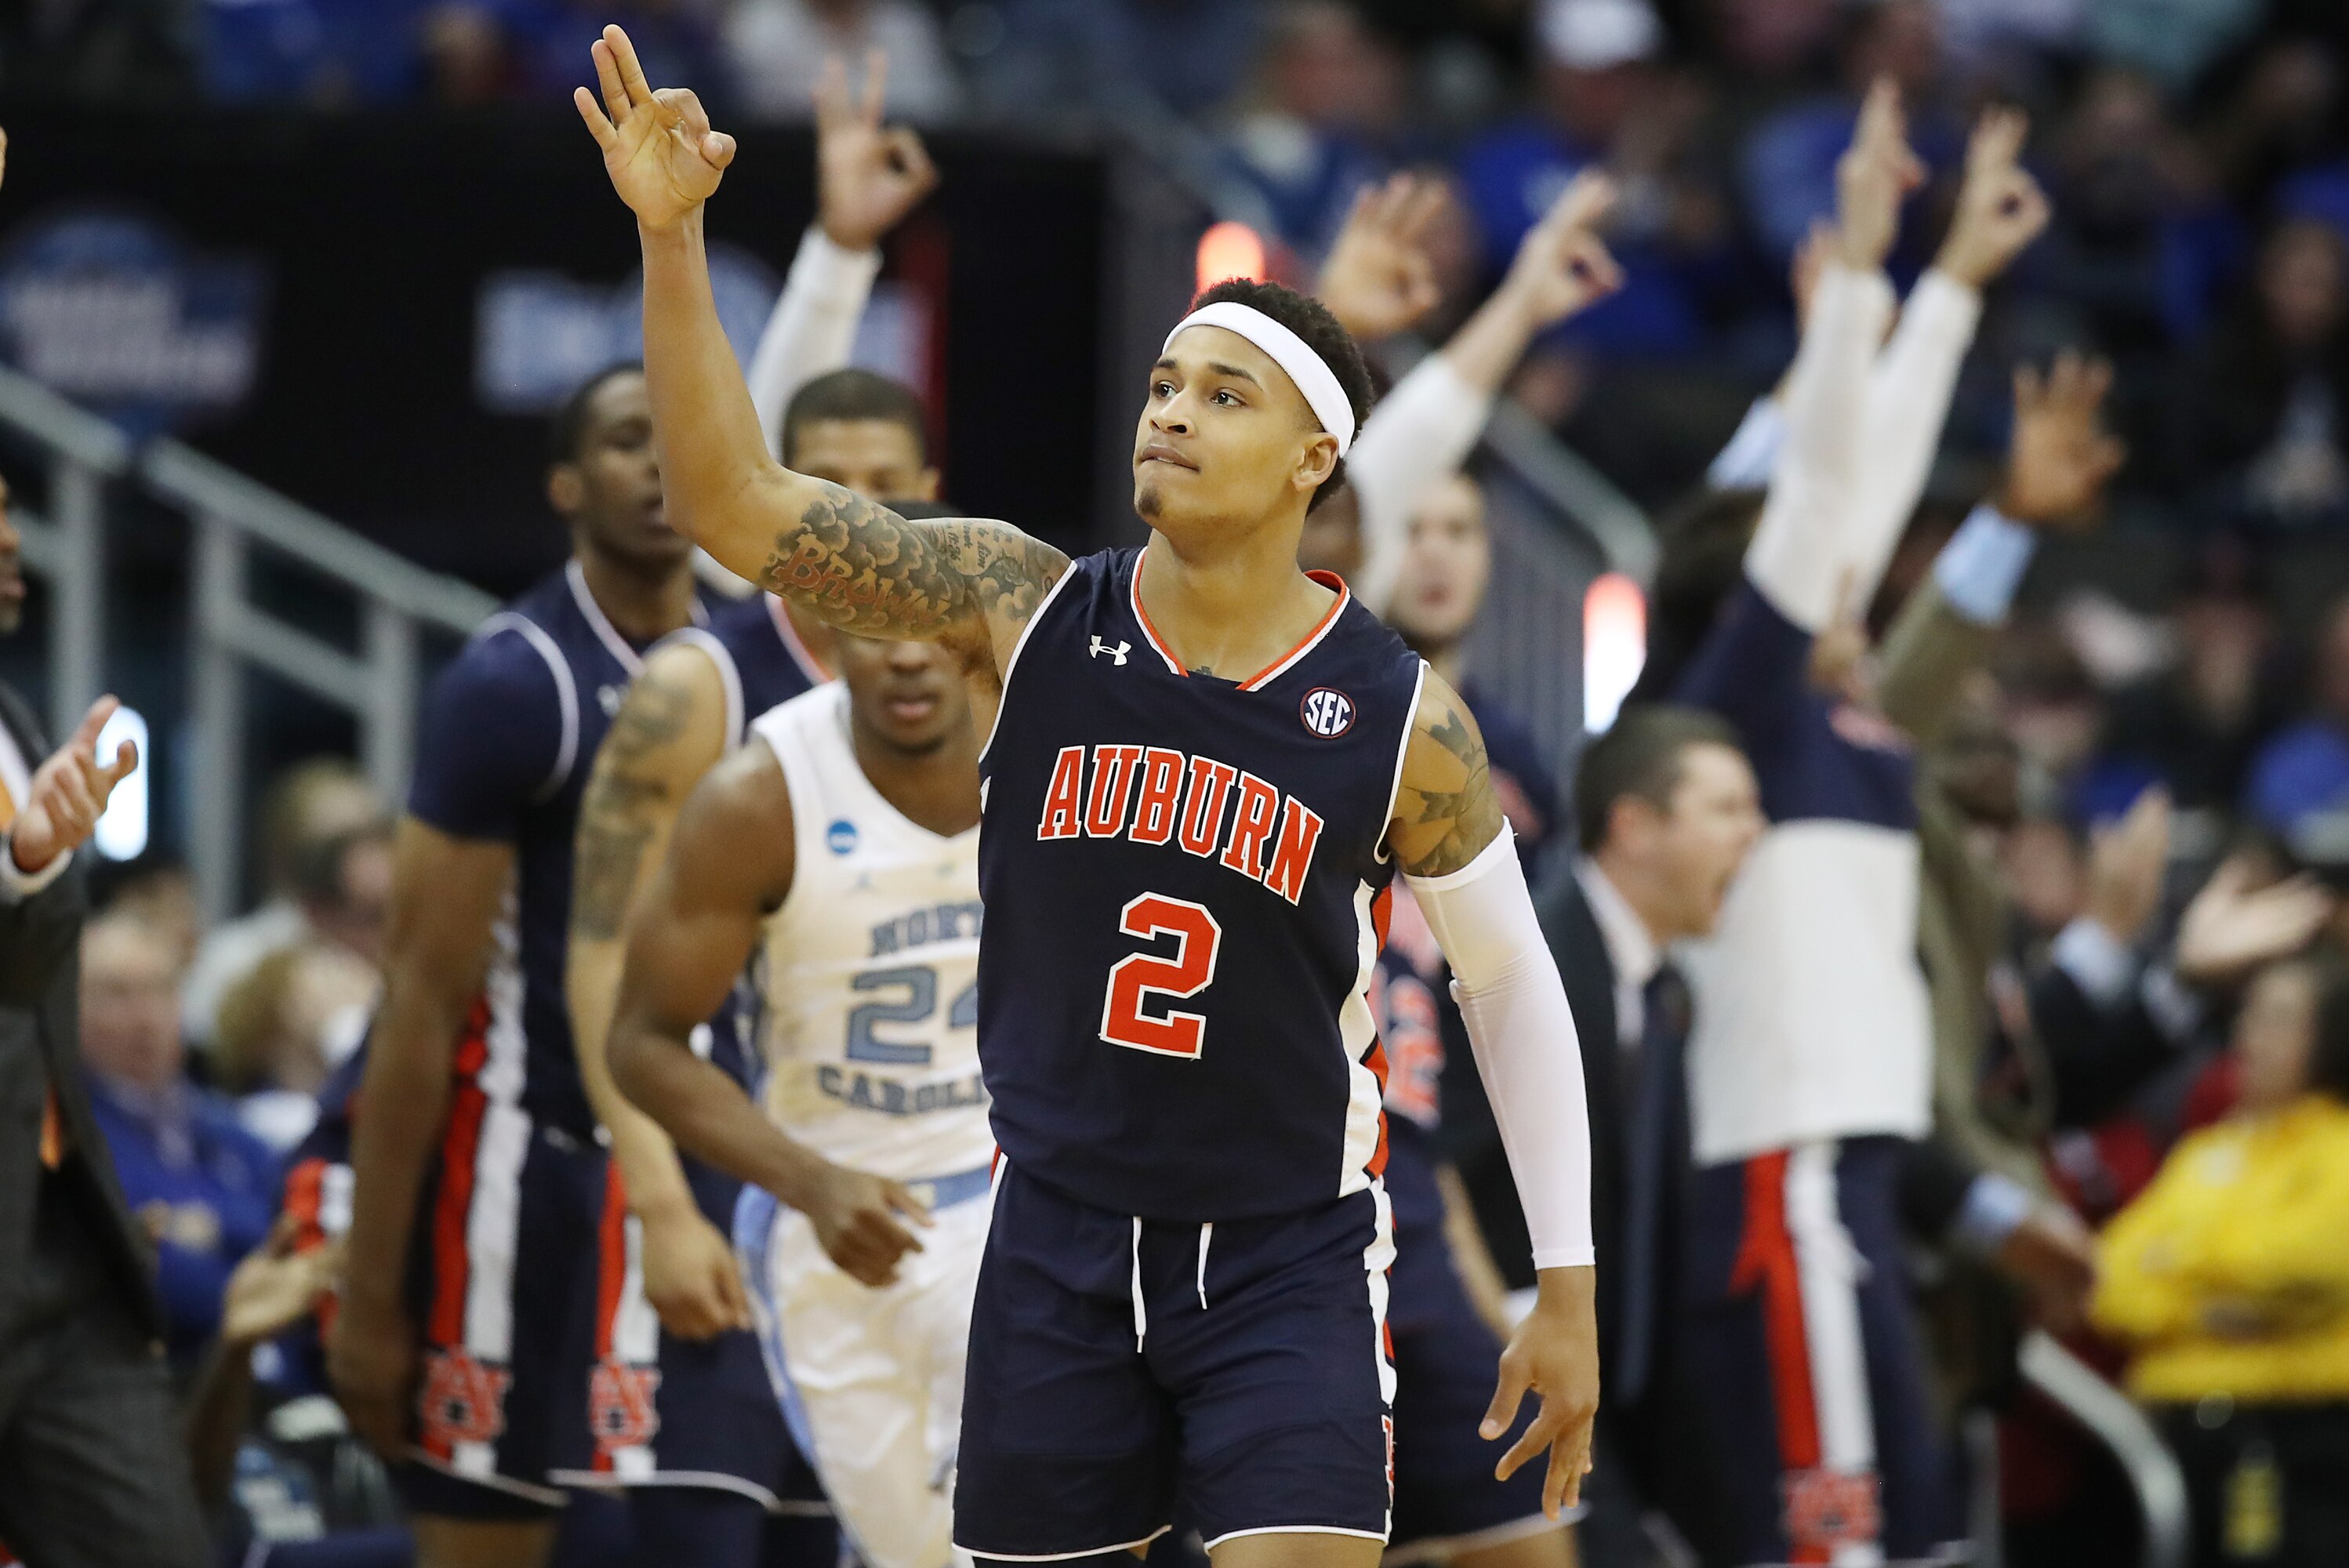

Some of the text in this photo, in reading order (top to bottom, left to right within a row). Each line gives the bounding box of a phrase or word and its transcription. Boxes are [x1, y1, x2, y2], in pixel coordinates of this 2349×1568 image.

[1304, 690, 1352, 735] SEC
[1037, 744, 1325, 907] AUBURN
[871, 900, 985, 956] NORT
[1098, 891, 1223, 1060] 2
[819, 1063, 993, 1116] CAROLI
